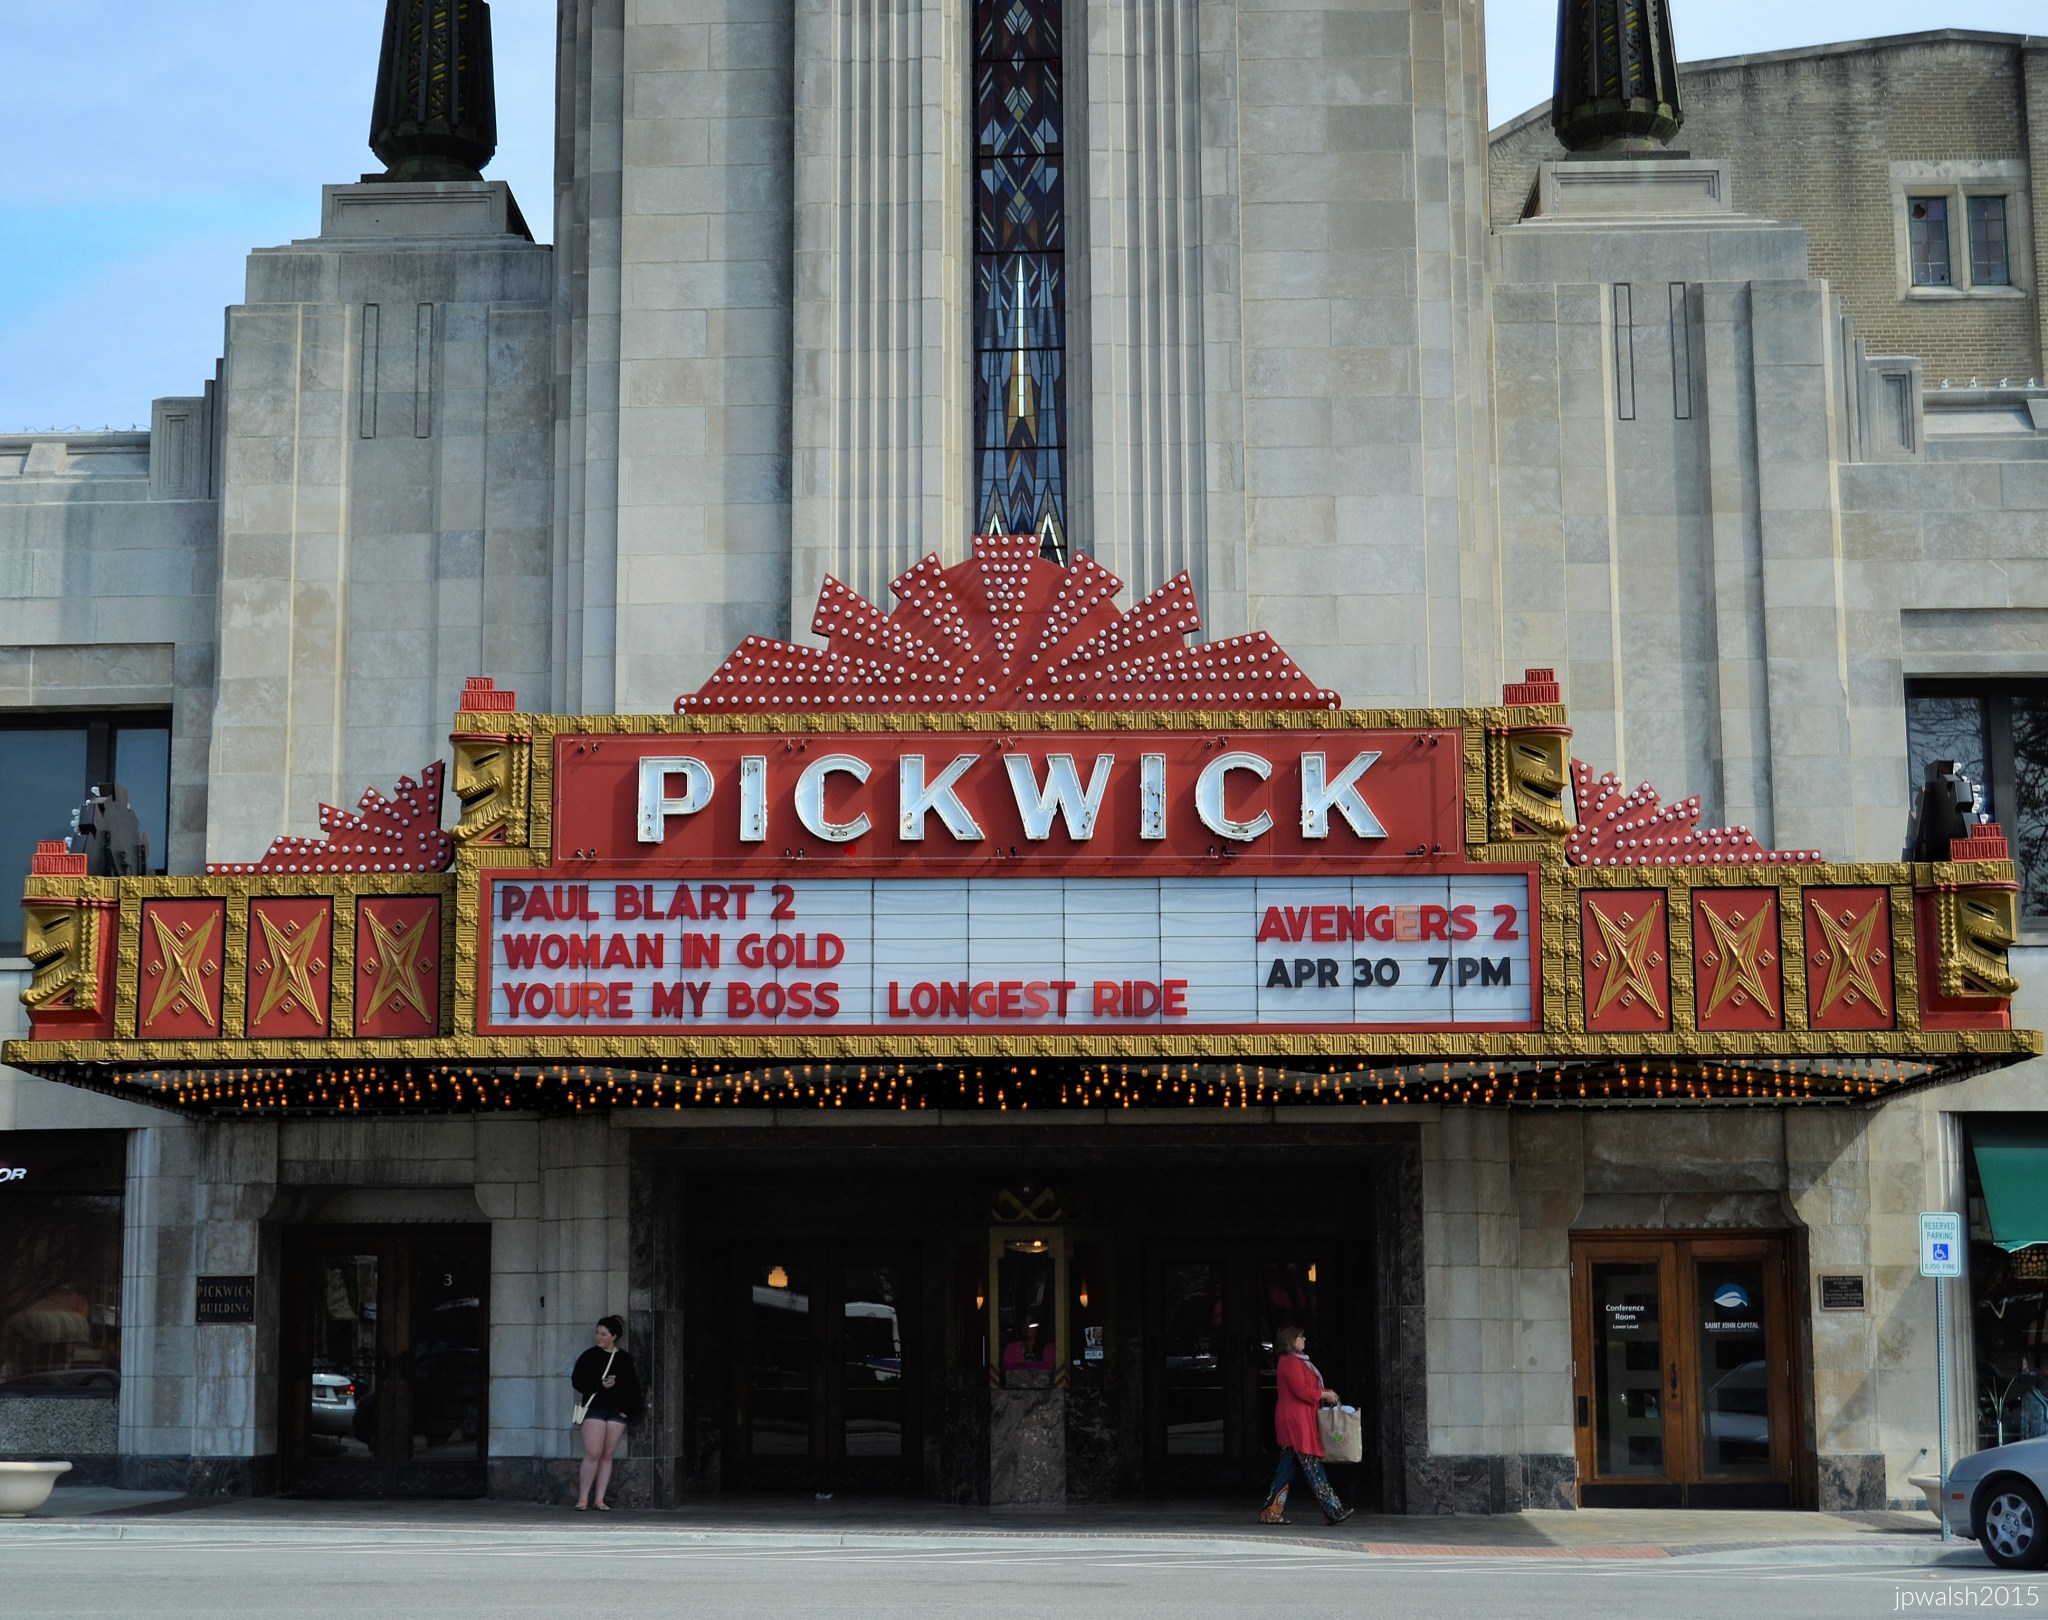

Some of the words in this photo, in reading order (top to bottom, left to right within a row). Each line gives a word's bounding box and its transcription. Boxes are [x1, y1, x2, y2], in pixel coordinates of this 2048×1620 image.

[637, 751, 1388, 844] PICKWICK
[502, 885, 600, 921] PAUL
[615, 884, 755, 921] BLART
[771, 885, 796, 921] 2
[1257, 905, 1478, 942] AVENGERS
[1493, 904, 1519, 941] 2
[503, 933, 664, 969] WOMAN
[682, 932, 720, 969] IN
[736, 932, 845, 969] GOLD
[1266, 958, 1340, 988] APR
[1353, 957, 1400, 988] 30
[502, 981, 633, 1018] YOURE
[652, 981, 711, 1018] MY
[727, 981, 840, 1018] BOSS
[888, 980, 1076, 1018] LONGEST
[1093, 979, 1189, 1017] RIDE
[1924, 1221, 1956, 1230] RESERVED
[1926, 1231, 1954, 1240] PARKING
[443, 1273, 453, 1287] 3
[197, 1285, 253, 1297] PICKWICK
[200, 1303, 250, 1313] BUILDING
[1605, 1304, 1645, 1312] Conference
[1615, 1313, 1636, 1321] Room
[1704, 1321, 1721, 1329] SAINT
[1721, 1321, 1736, 1329] JOHN
[1736, 1321, 1759, 1329] CAPITAL
